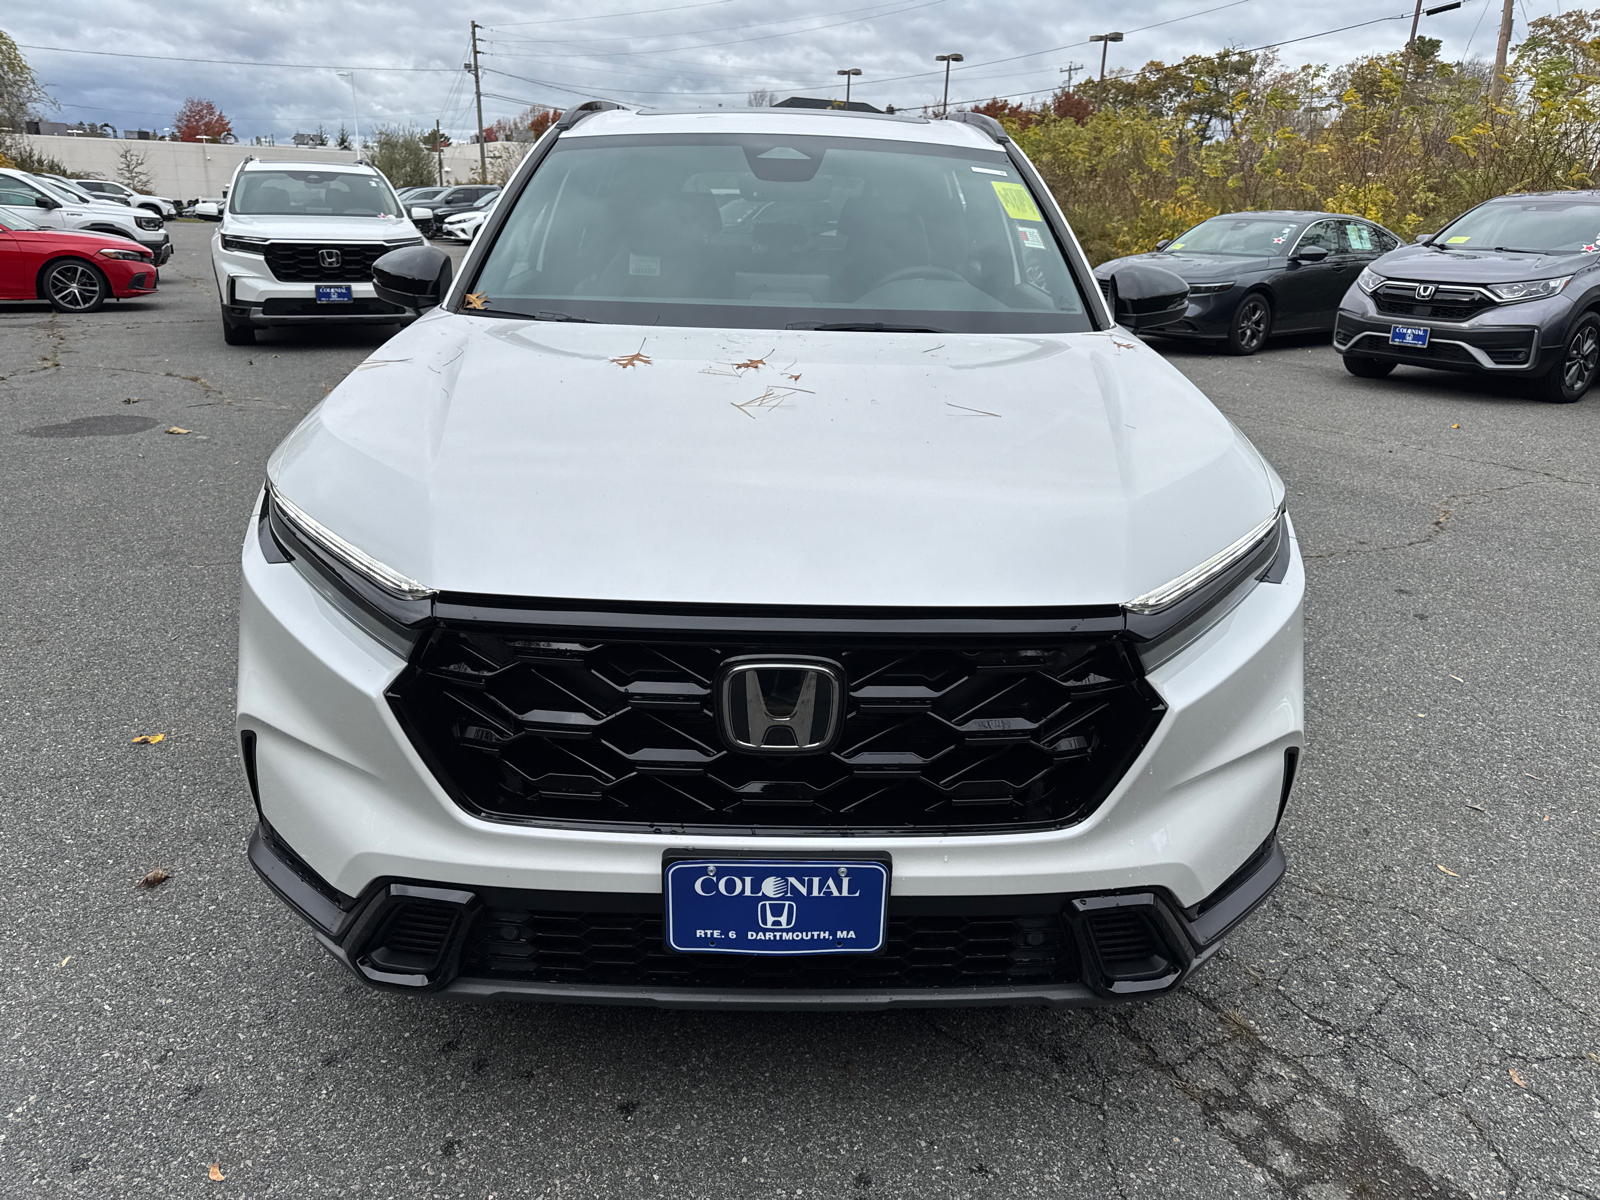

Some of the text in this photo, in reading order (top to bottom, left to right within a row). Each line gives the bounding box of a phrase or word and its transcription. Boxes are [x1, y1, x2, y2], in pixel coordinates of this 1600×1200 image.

[694, 875, 861, 898] COLONIAL
[696, 929, 857, 941] RTE. 6 DARTMOUTH, MA
